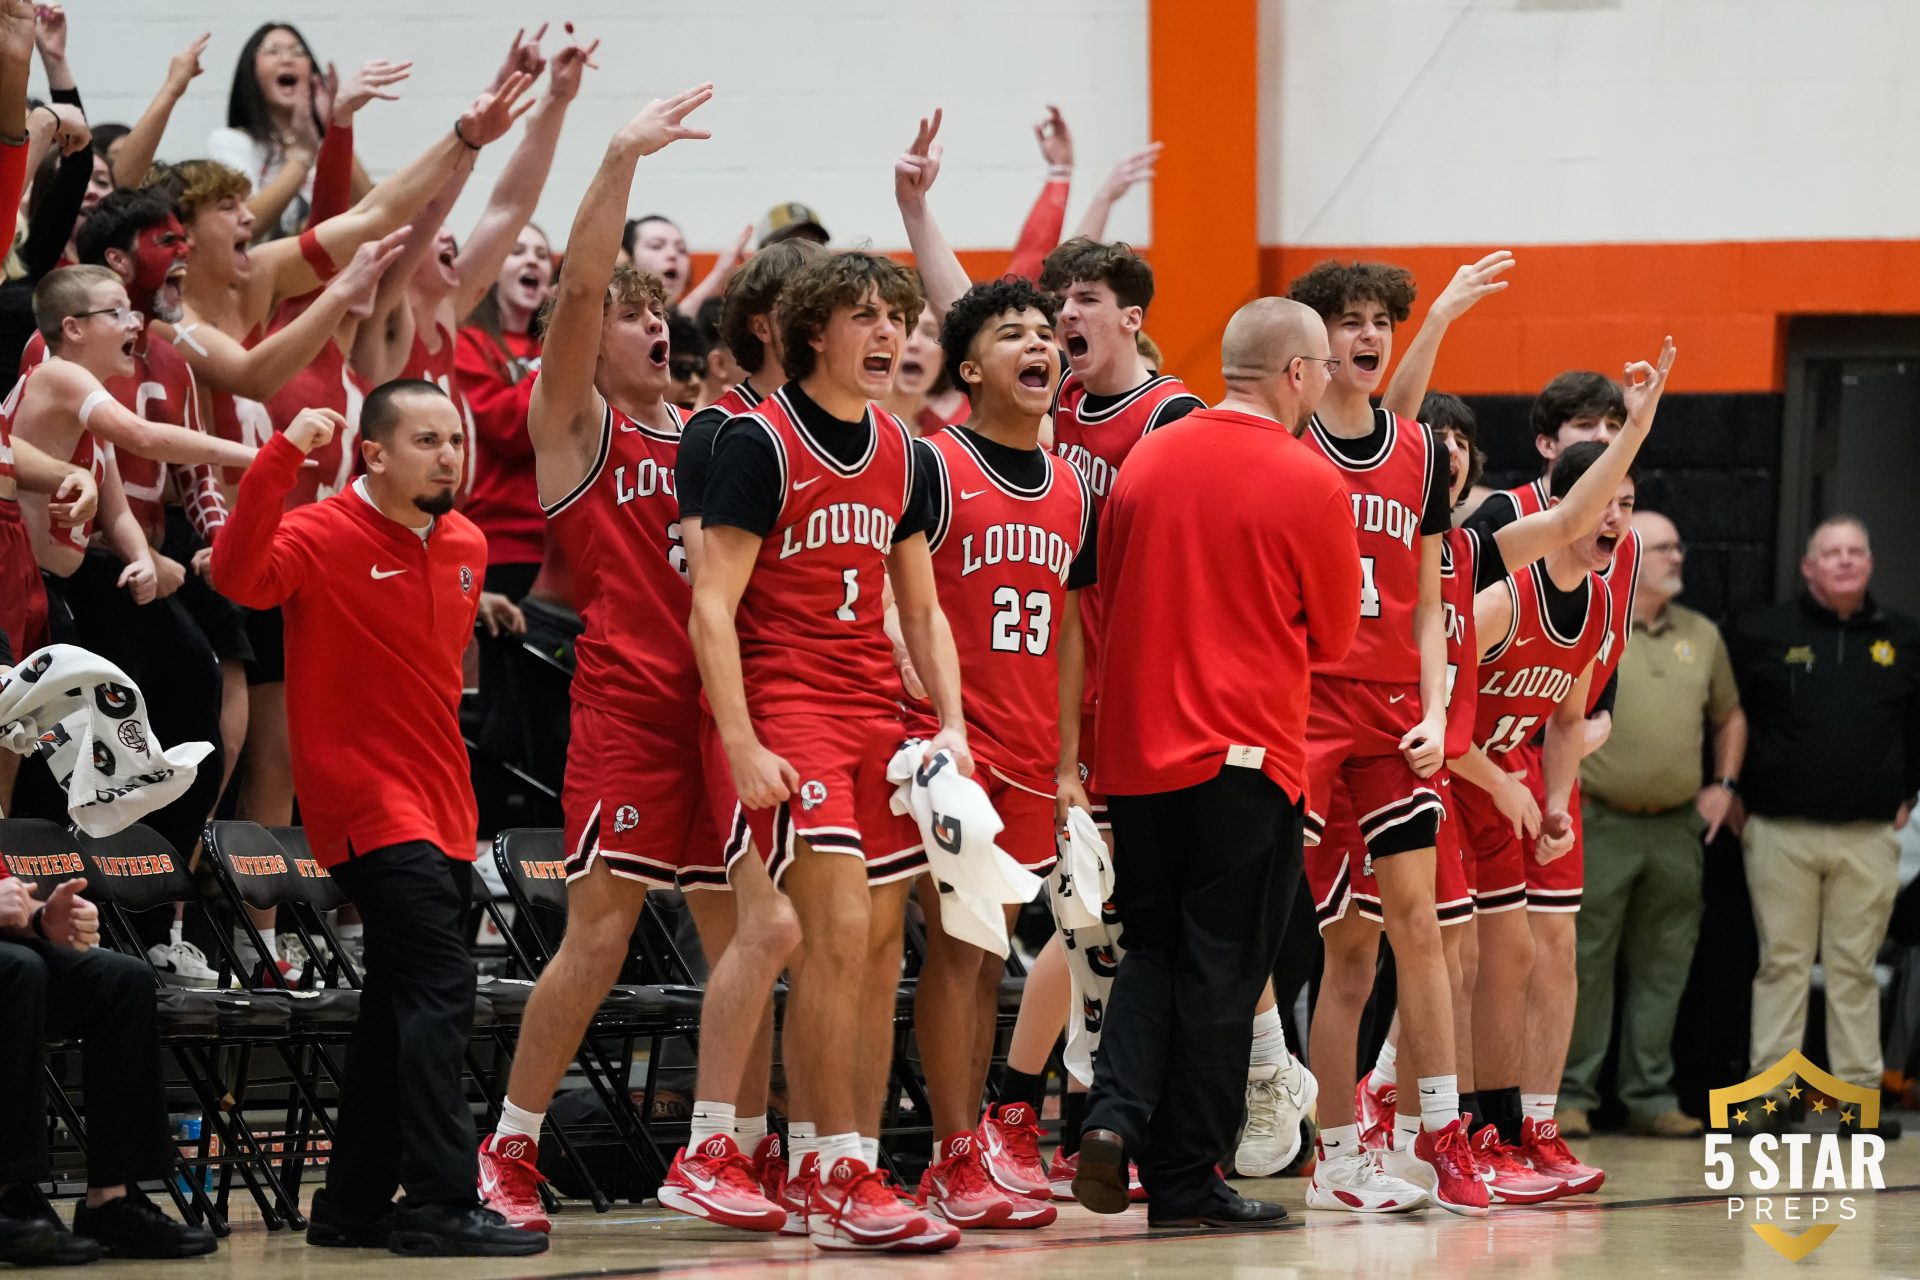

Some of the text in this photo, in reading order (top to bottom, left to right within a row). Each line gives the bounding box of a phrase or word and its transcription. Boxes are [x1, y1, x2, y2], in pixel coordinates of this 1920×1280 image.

[779, 502, 896, 560] LOUDON
[961, 523, 1073, 587] LOUDON
[836, 568, 859, 621] 1
[991, 585, 1051, 657] 23
[1479, 665, 1578, 704] LOUDO
[1480, 714, 1539, 756] 15
[5, 853, 85, 876] PANTHERS
[92, 854, 175, 877] PANTHERS
